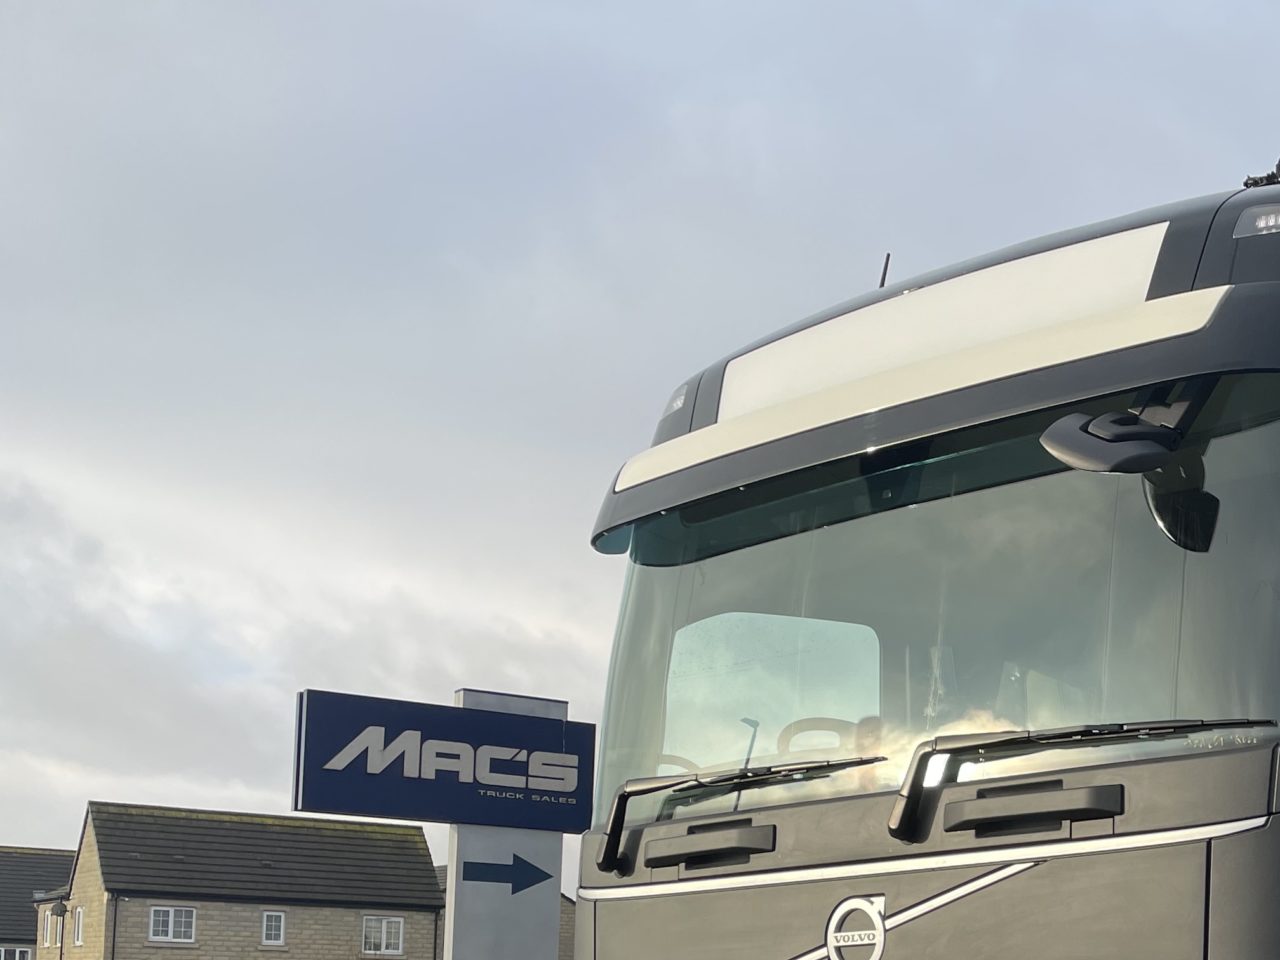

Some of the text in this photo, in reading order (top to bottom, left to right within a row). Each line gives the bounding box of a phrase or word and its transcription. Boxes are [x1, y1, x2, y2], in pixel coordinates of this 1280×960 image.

[477, 789, 577, 805] TRUCK SALES
[833, 932, 876, 944] VOLVO
